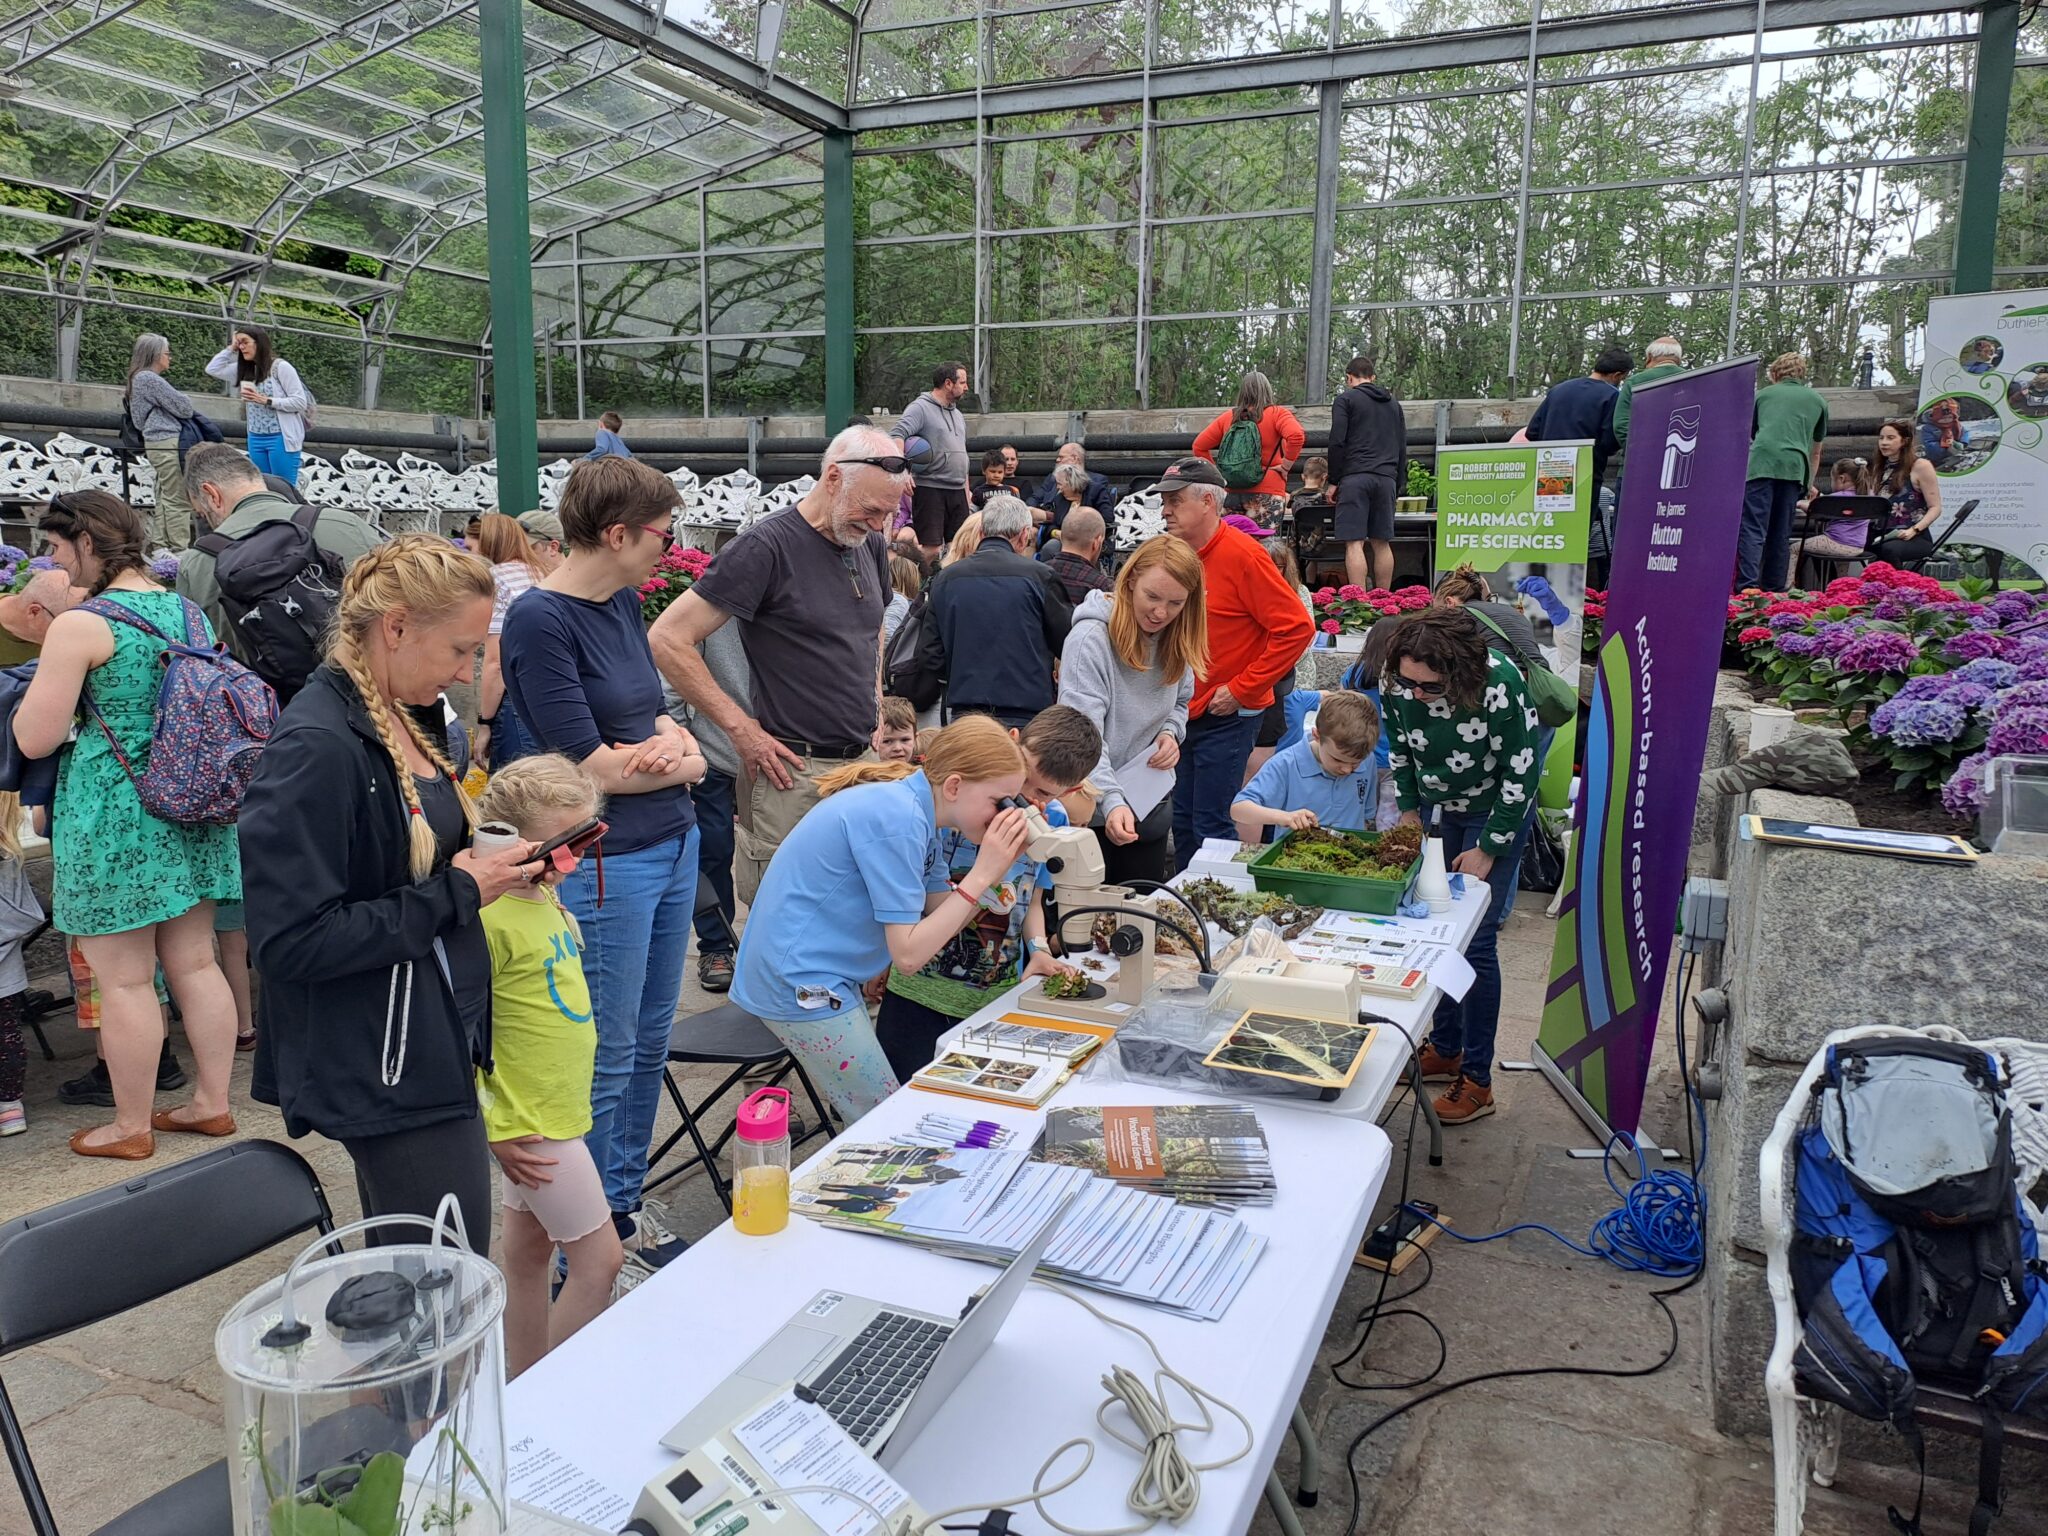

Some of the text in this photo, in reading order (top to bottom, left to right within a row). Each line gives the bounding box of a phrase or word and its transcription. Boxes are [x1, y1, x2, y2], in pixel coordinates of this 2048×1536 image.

[1464, 462, 1526, 473] ROBERT GORDON
[1464, 472, 1526, 481] UNIVERSITY ABERDEEN
[1448, 490, 1516, 505] School of
[1656, 501, 1686, 518] The James
[1984, 513, 2018, 521] 580165
[1447, 511, 1554, 527] PHARMACY &
[1446, 534, 1565, 550] LIFE SCIENCES
[1651, 523, 1682, 545] Hutton
[1647, 551, 1678, 572] Institute
[1632, 615, 1653, 982] Action-based research
[1128, 1116, 1141, 1146] Woodland
[1145, 1156, 1157, 1166] and
[963, 1151, 1008, 1203] Hutton Highlights
[1011, 1166, 1034, 1188] Hutton
[1145, 1209, 1187, 1265] Hutton Highlights
